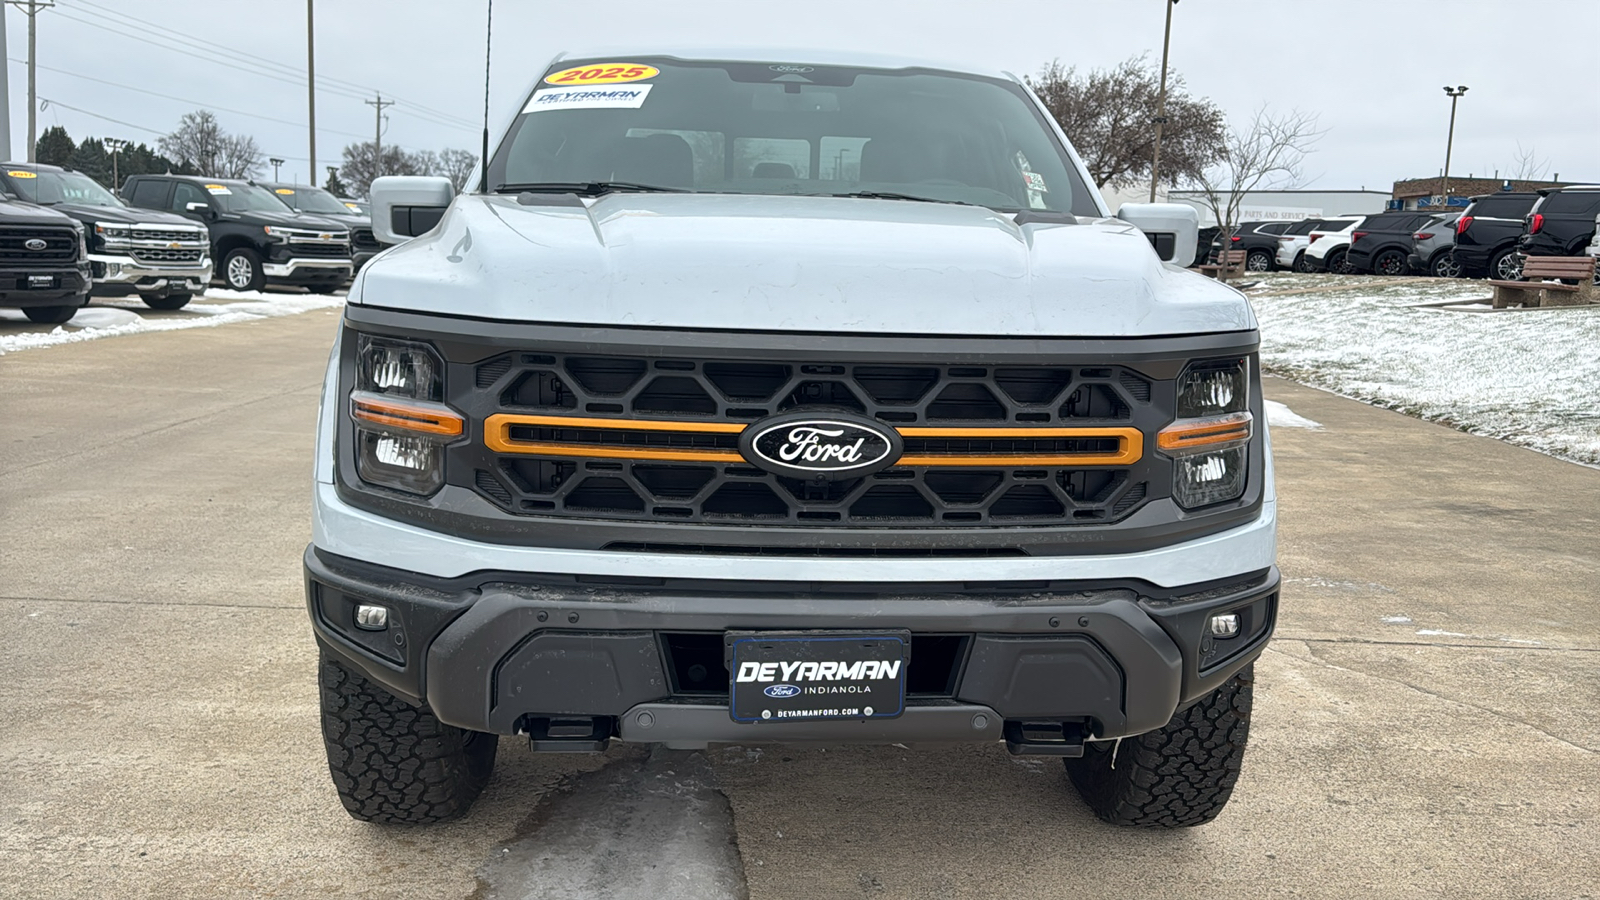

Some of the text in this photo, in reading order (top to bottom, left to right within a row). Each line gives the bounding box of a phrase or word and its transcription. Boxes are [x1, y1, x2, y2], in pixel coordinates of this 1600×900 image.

[777, 65, 806, 73] Ford
[555, 67, 648, 83] 2025
[537, 91, 642, 102] DEYARMAN
[1244, 210, 1263, 218] PARTS
[1264, 211, 1279, 219] AND
[779, 427, 865, 462] Ford
[736, 660, 901, 683] DEYARMAN
[771, 685, 872, 696] Ford INDIANOLA
[777, 708, 859, 718] DEYARMANFORD.COM
